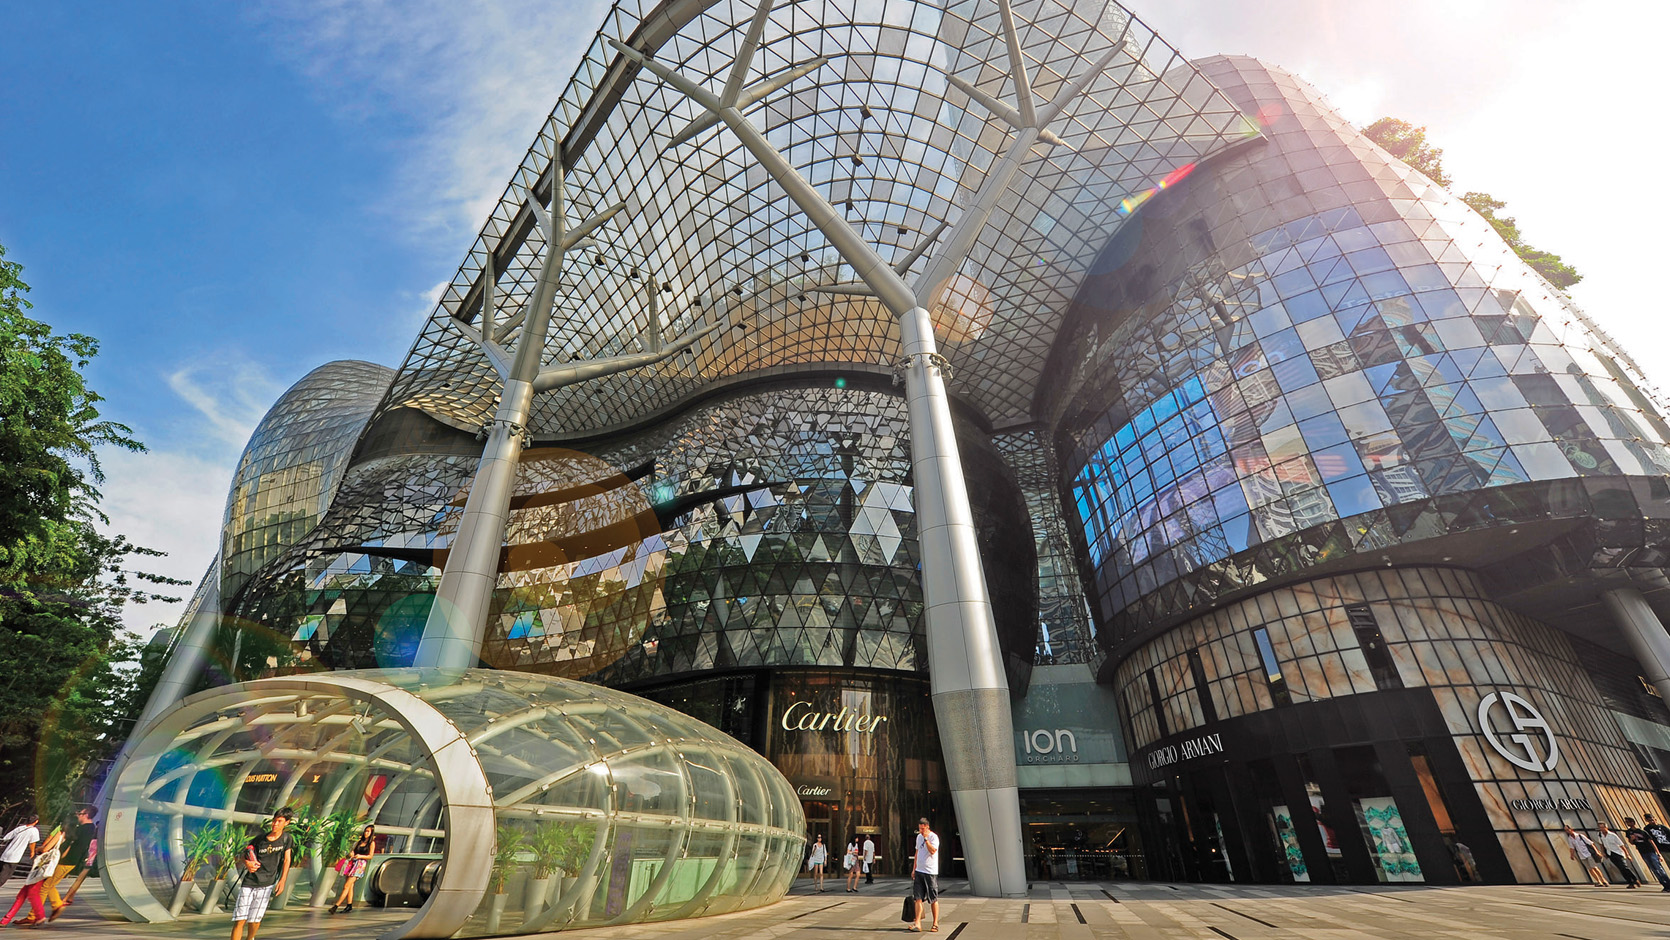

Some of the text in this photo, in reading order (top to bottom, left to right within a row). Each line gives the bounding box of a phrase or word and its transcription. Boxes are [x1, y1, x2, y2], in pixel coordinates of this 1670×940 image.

[781, 701, 887, 733] Cartier
[1147, 733, 1224, 770] GIORGIO ARMANI
[1027, 755, 1079, 763] ORCHARD
[255, 773, 278, 783] VUITTON
[797, 785, 832, 796] Cartier
[1512, 799, 1558, 811] GIORGIO
